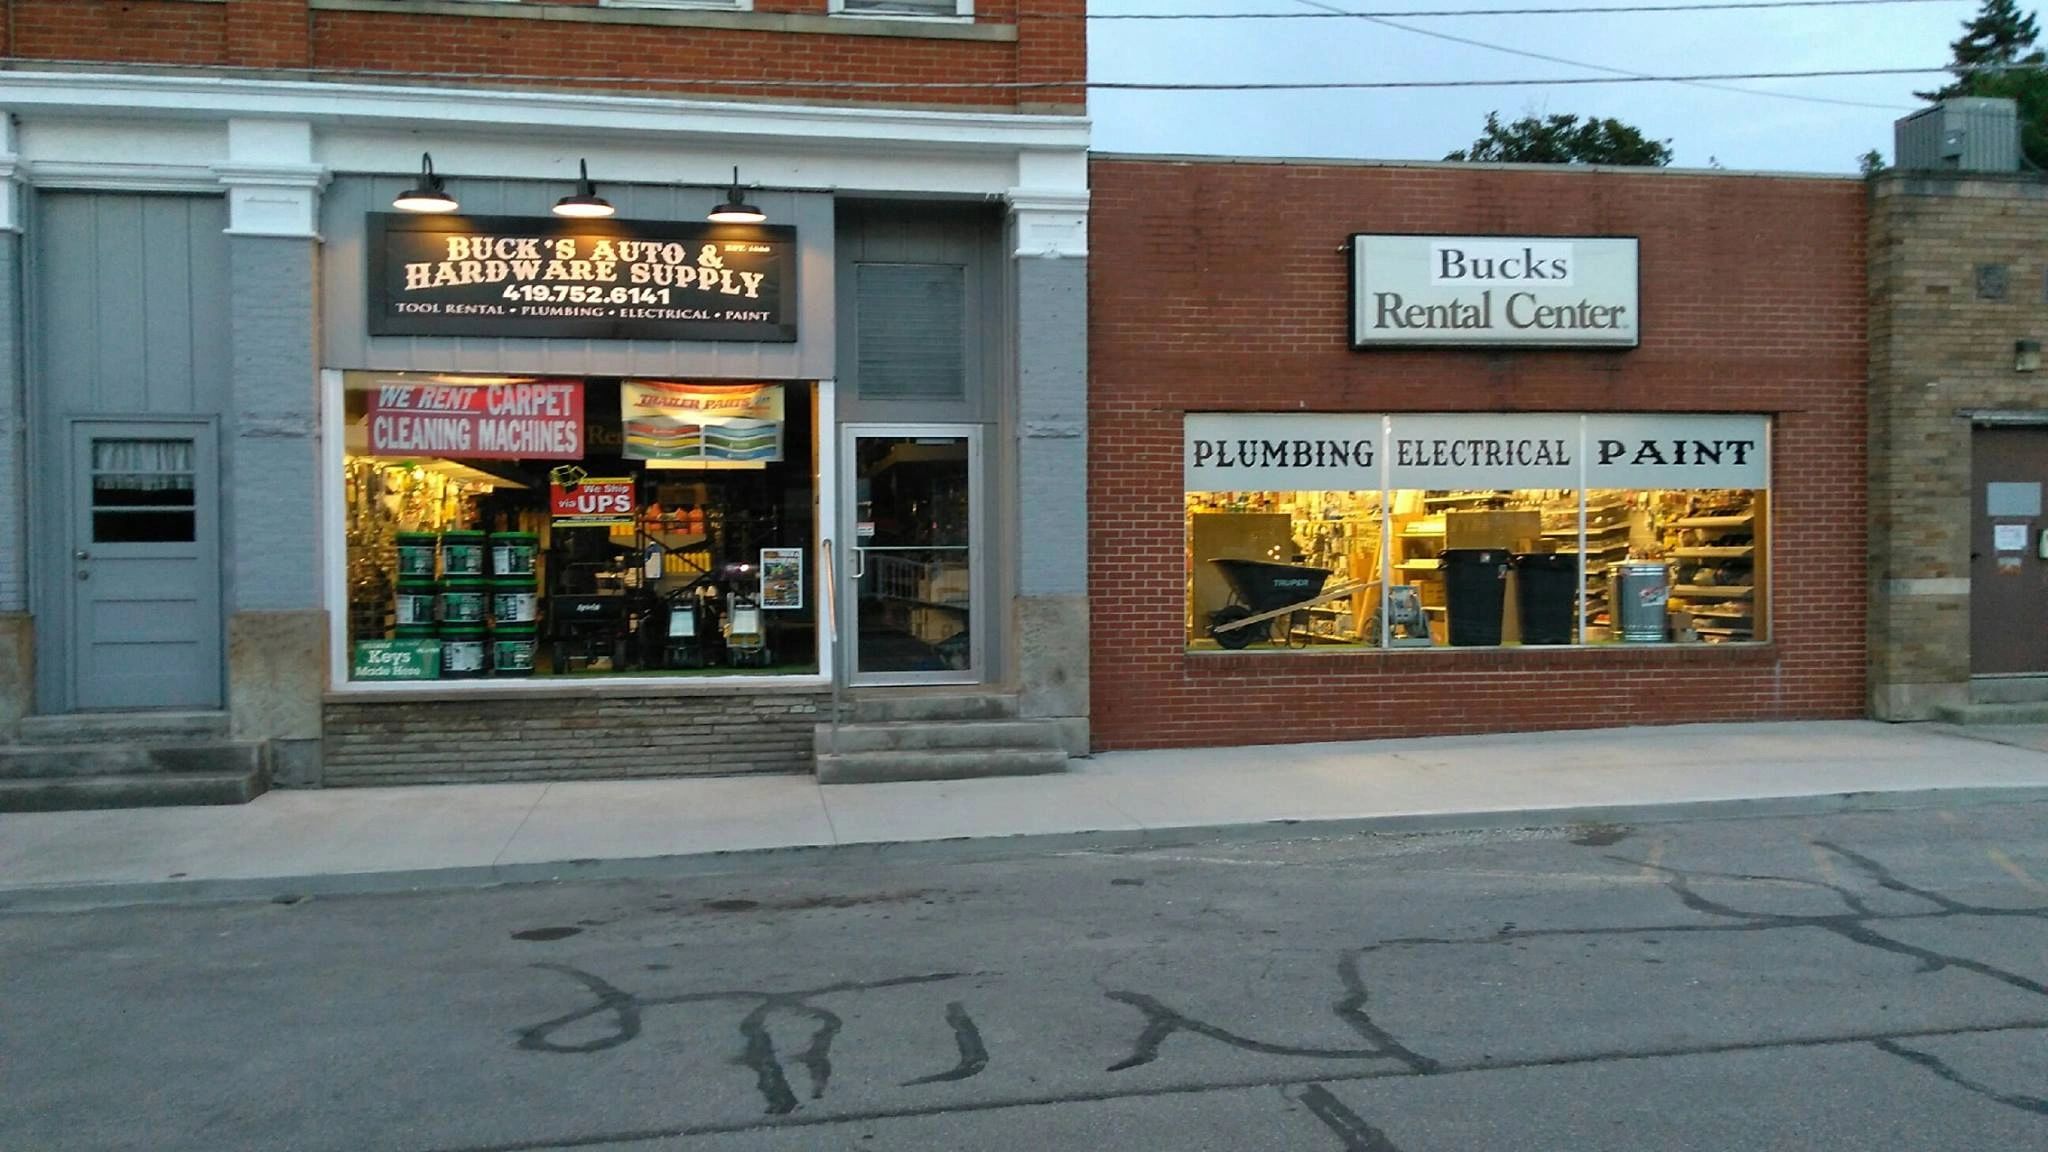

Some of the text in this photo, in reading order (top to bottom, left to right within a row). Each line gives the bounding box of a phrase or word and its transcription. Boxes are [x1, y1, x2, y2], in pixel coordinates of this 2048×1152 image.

[446, 236, 723, 269] BUCK'S AUTO &
[1439, 248, 1568, 280] Bucks
[405, 260, 764, 299] HARDWARE SUPPLY
[502, 285, 670, 305] 419.752.6141
[396, 302, 770, 322] TOOL RENTAL PLUMBING ELECTRICAL PAINT
[1373, 291, 1626, 329] Rental Center
[378, 385, 574, 416] WE RENT CARPET
[634, 394, 699, 409] TRAILER
[702, 397, 754, 409] PARTS
[373, 416, 577, 452] CLEANING MACHINES
[1193, 440, 1374, 467] PLUMBING
[1397, 440, 1571, 466] ELECTRICAL
[1598, 440, 1754, 465] PAINT
[583, 485, 630, 495] We Ship
[578, 494, 630, 513] UPS
[368, 650, 411, 666] Keys
